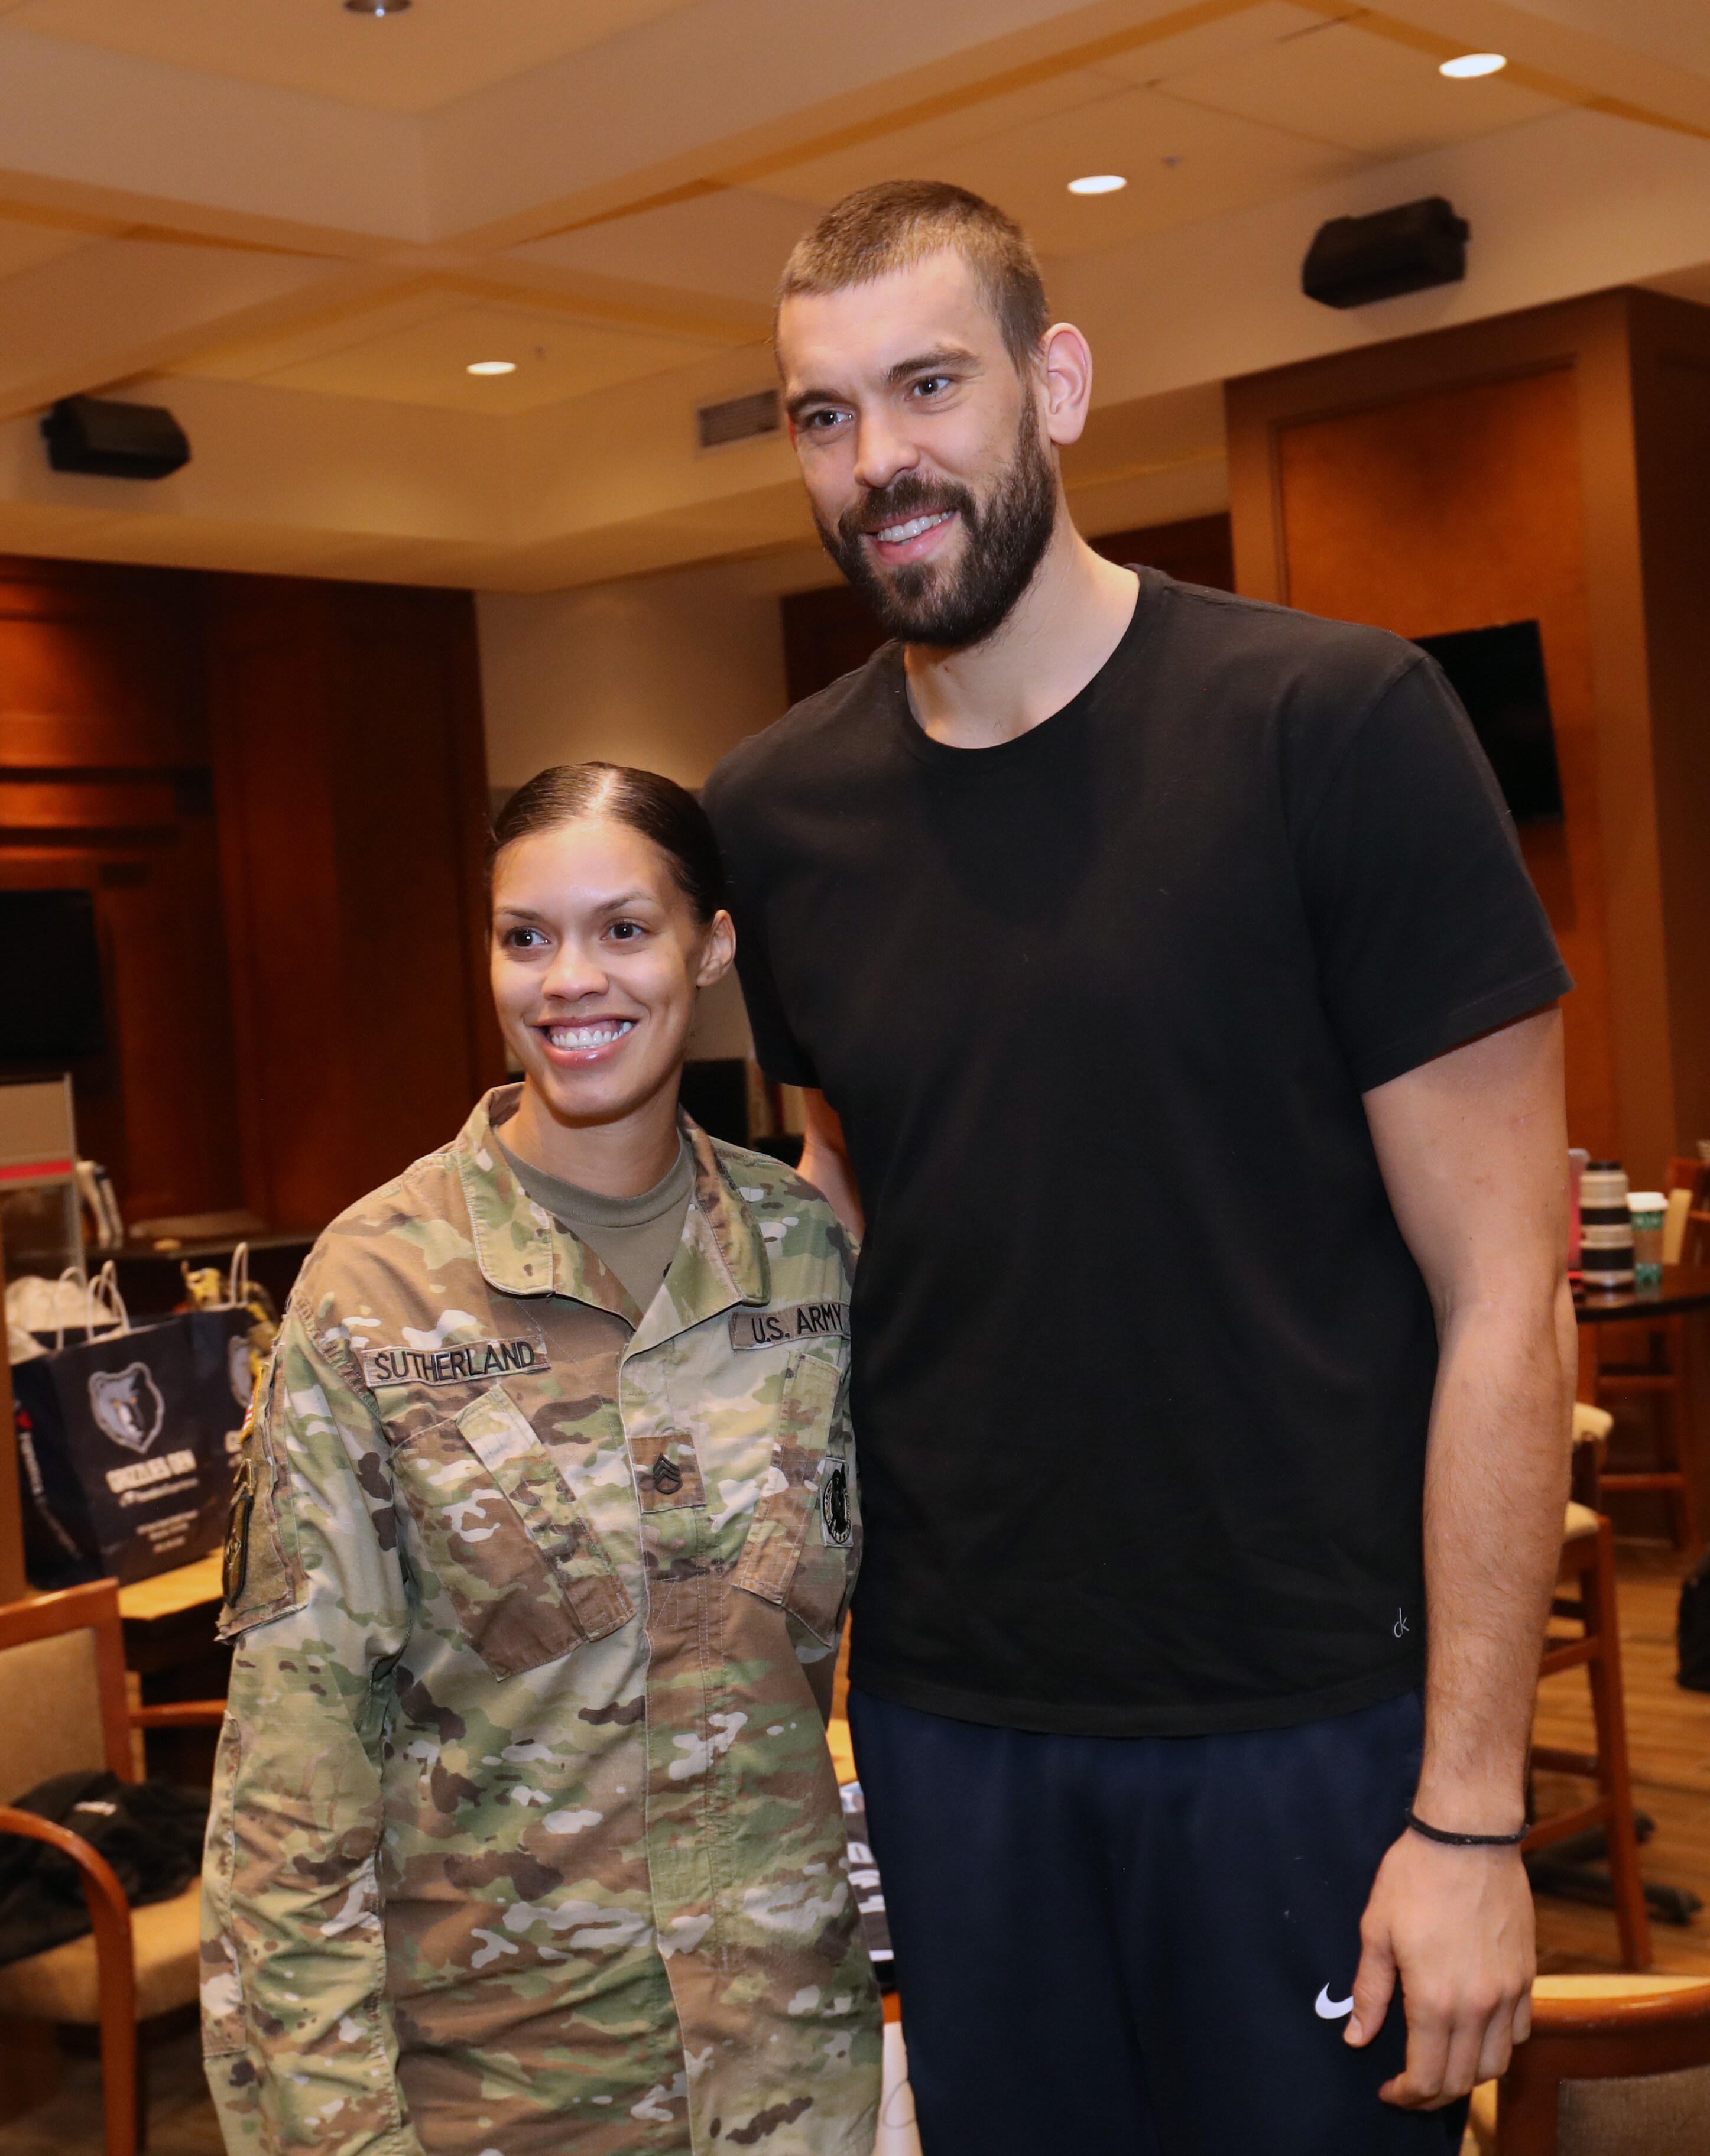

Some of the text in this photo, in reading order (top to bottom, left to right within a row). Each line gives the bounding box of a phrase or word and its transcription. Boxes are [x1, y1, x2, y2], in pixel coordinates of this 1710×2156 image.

[751, 1304, 843, 1344] U.S. ARMY
[374, 1341, 536, 1382] SUTHERLAND
